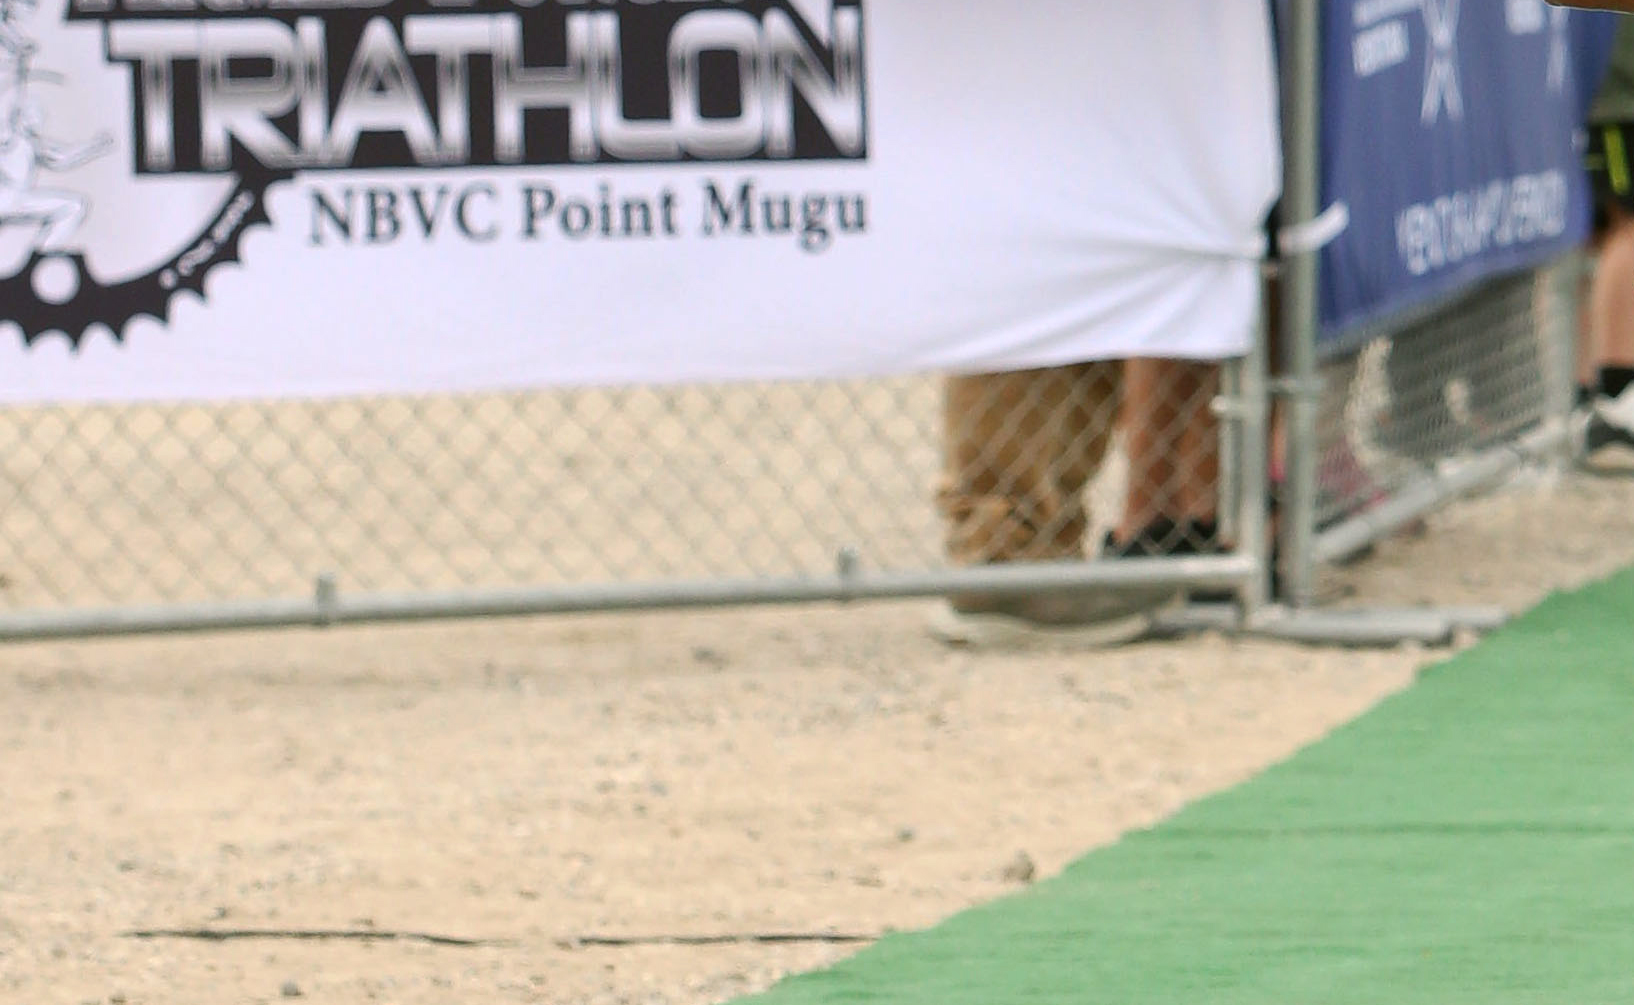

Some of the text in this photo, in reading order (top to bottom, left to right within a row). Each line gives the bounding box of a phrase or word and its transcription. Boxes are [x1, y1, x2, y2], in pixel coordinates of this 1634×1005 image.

[110, 7, 864, 171] TRIATHLON
[308, 187, 499, 245] NBVC
[521, 184, 680, 242] Point
[703, 179, 868, 253] Mugu
